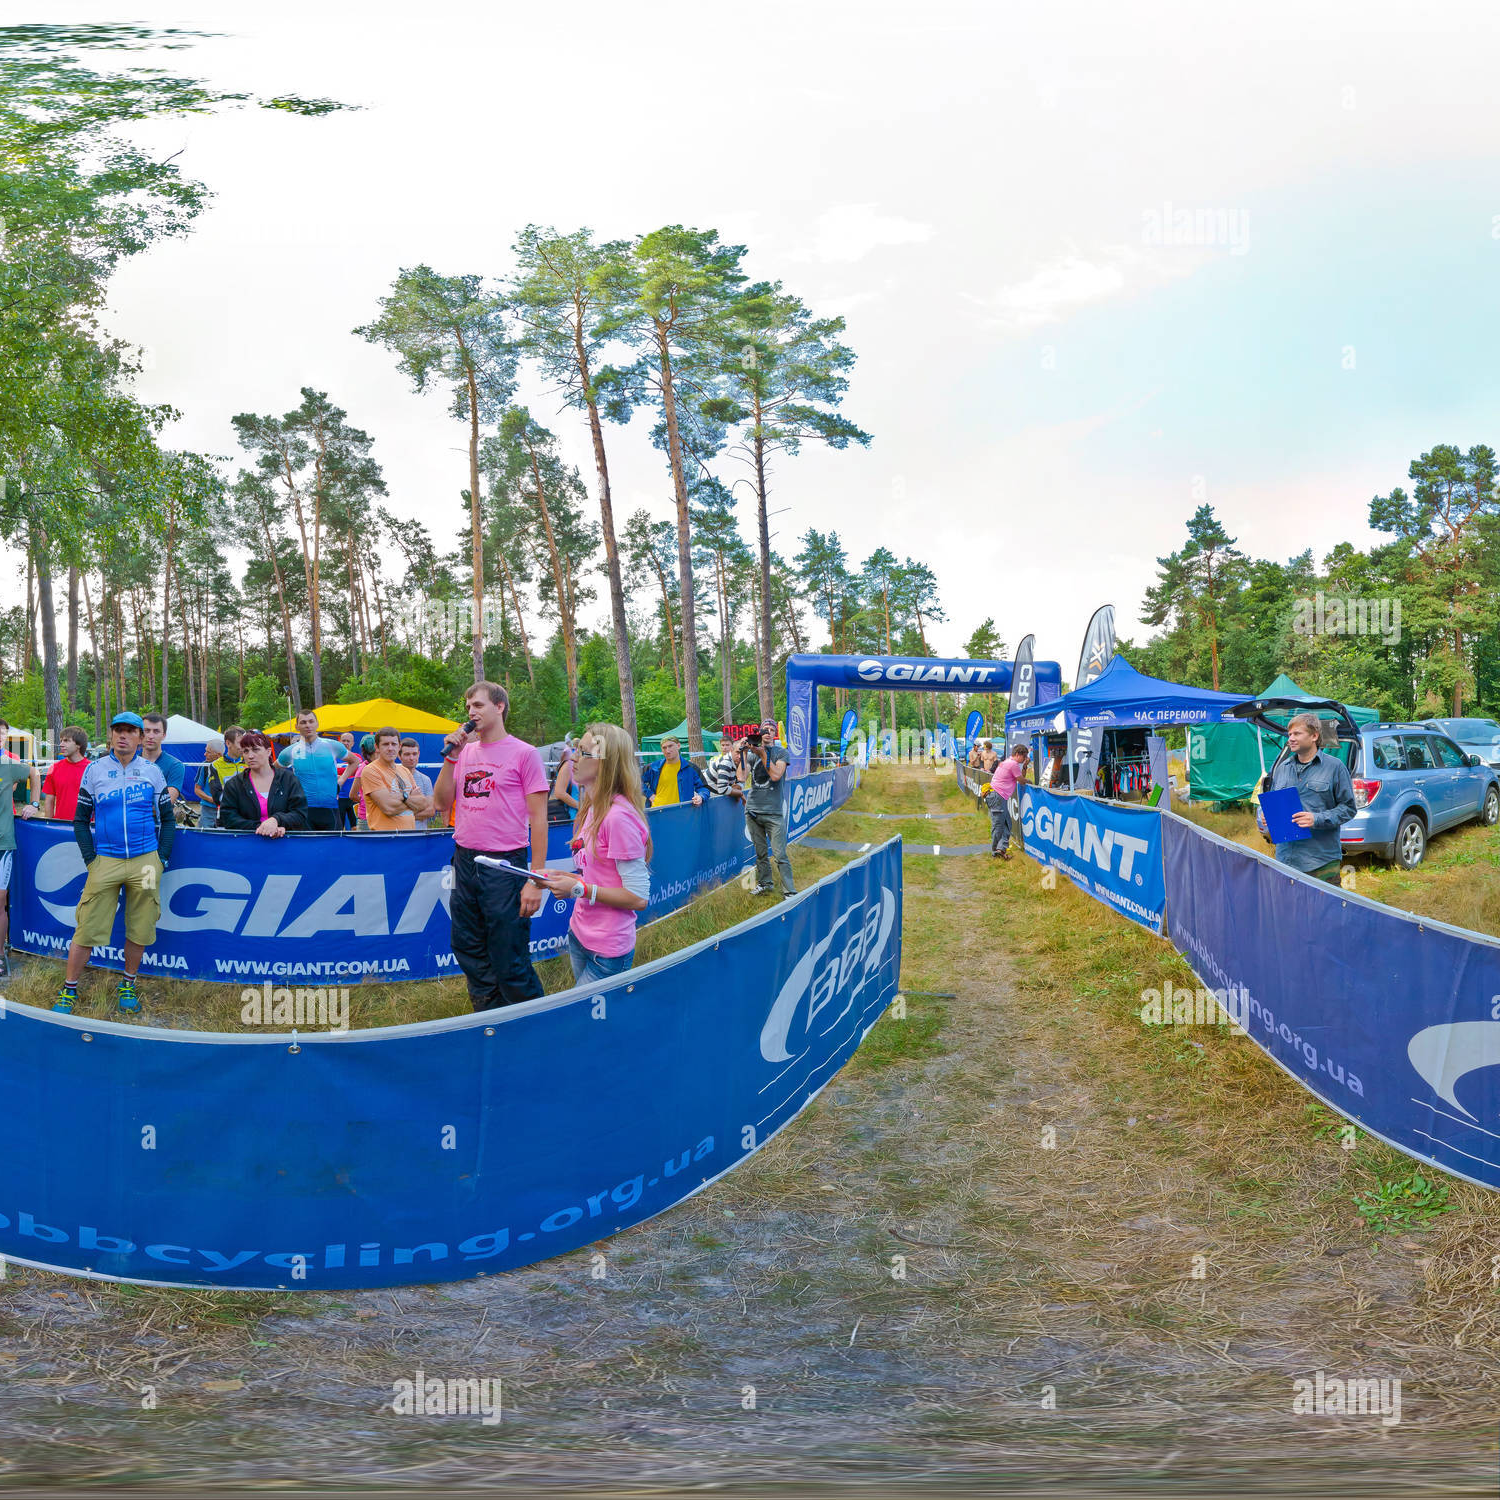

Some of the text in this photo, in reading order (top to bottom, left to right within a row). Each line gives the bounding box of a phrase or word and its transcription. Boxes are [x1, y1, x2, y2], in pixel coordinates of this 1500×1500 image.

[886, 663, 997, 684] GIANT
[1134, 710, 1207, 721] ЧАС ПЕРЕМОГИ
[804, 780, 833, 814] GIANT
[1034, 806, 1149, 882] GIANT
[215, 957, 410, 978] WWW.GIANT.COM.UA
